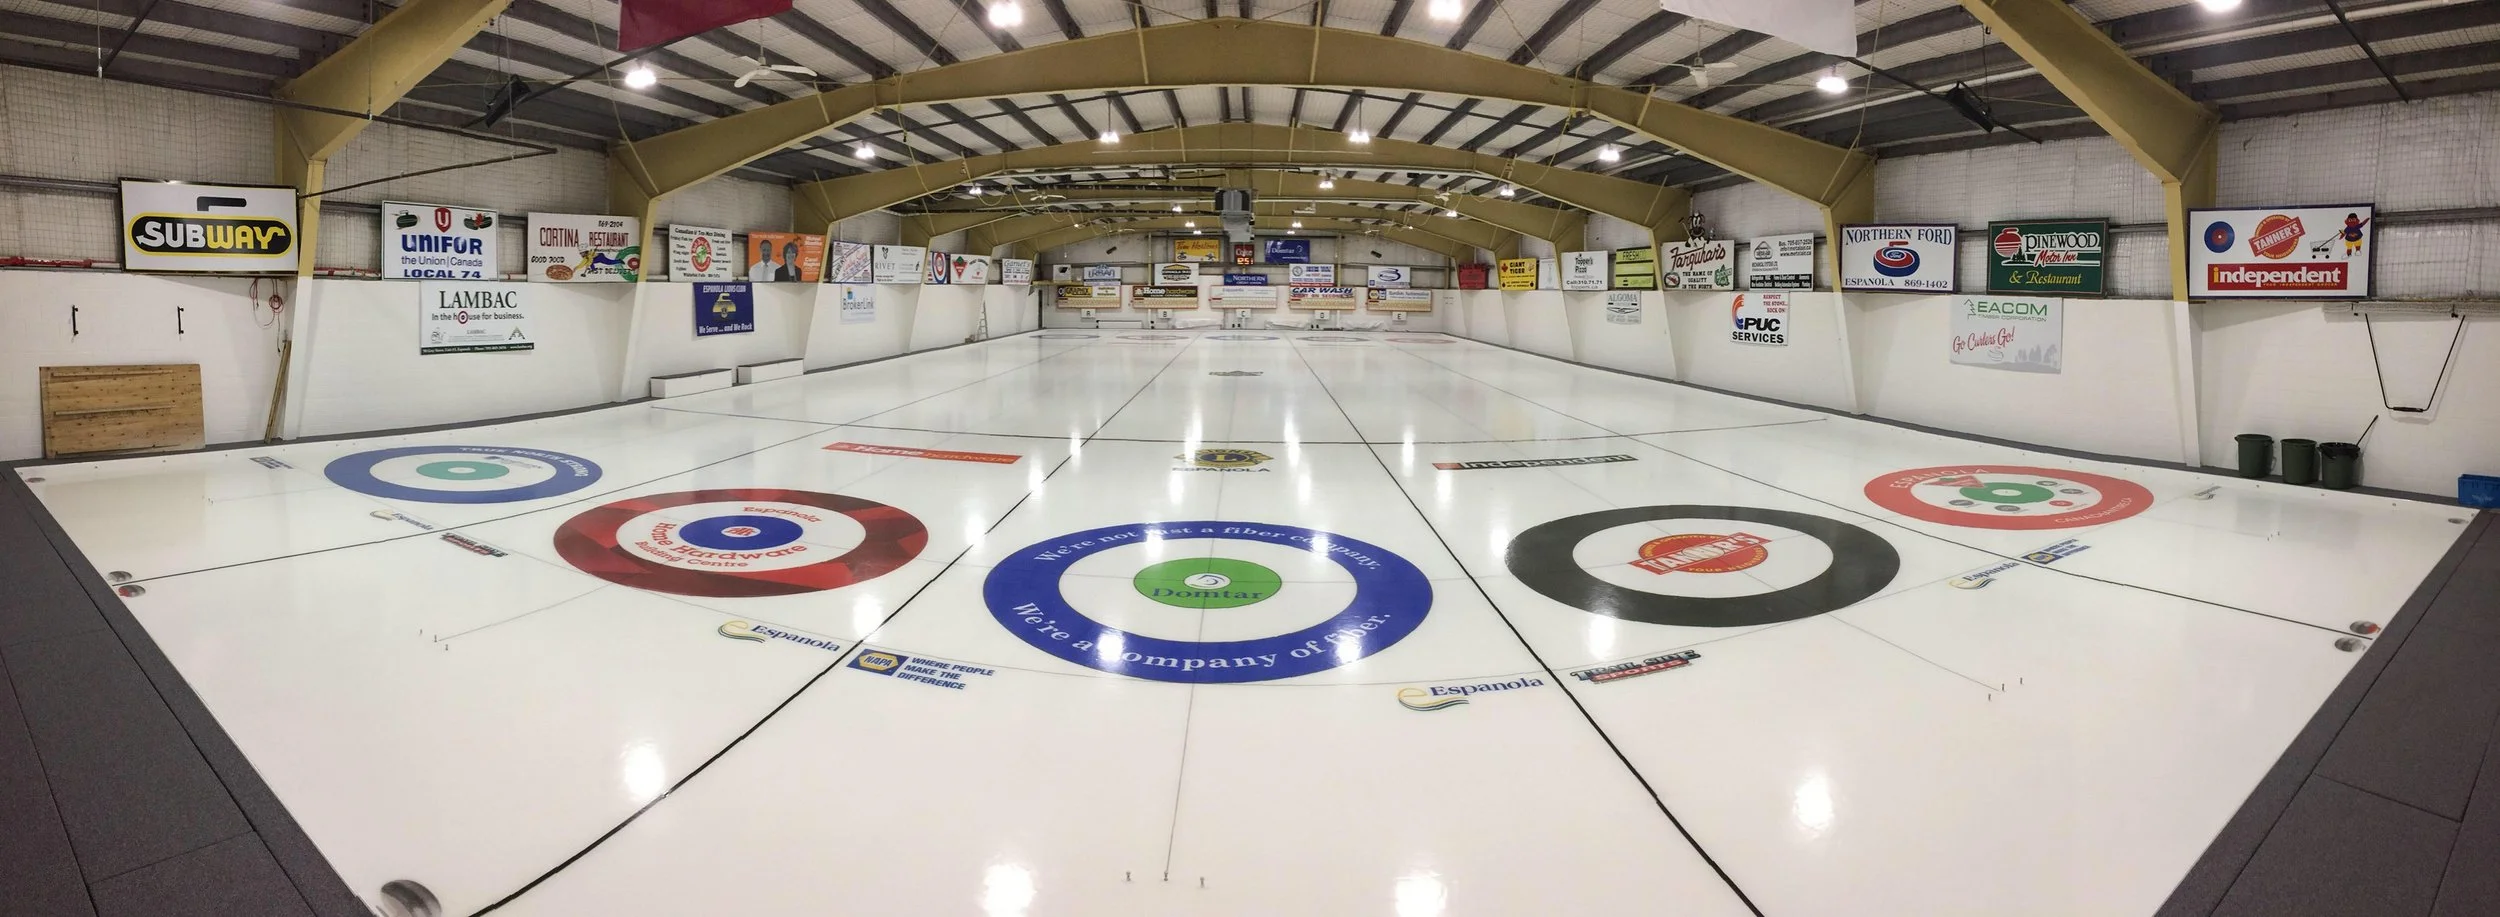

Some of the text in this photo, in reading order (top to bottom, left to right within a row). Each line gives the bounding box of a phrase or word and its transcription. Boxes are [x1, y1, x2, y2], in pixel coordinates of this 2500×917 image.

[137, 220, 285, 251] SUBWAY
[540, 227, 629, 247] CORTINA RESTAURANT
[1845, 228, 1952, 245] NORTHERN FORD
[2254, 223, 2300, 249] TANNER'S
[1177, 241, 1189, 250] Tim
[401, 256, 483, 267] the Union Canada
[1670, 243, 1726, 270] Farquhar's
[2035, 250, 2076, 266] Motor Inn
[404, 269, 481, 279] LOCAL 74
[875, 262, 896, 270] RIVET
[1845, 278, 1948, 289] ESPANOLA 869-1402
[2009, 270, 2082, 285] & Restaurant
[2213, 266, 2341, 287] independent
[702, 284, 724, 293] ESPANOLA
[1143, 287, 1166, 295] Home
[439, 290, 518, 309] LAMBAC
[842, 298, 874, 311] BrokerLink
[1608, 293, 1638, 302] ALGOMA
[494, 312, 525, 320] business.
[1977, 301, 2048, 316] EACOM
[699, 322, 753, 334] We Serve and We Rock
[1744, 317, 1781, 332] PUC
[1732, 331, 1785, 343] SERVICES
[1953, 325, 2016, 354] Go Curlers Go!
[1889, 468, 1989, 489] ESPANOLA
[742, 506, 823, 523] Espanola
[652, 522, 808, 560] Home Hardware
[1034, 539, 1096, 561] We're
[1098, 531, 1139, 543] not
[1223, 526, 1285, 538] fiber
[635, 540, 749, 567] Building Centre
[1151, 587, 1263, 600] Domtar
[751, 624, 841, 652] Espanola
[1012, 602, 1070, 641] We're
[1072, 640, 1093, 651] a
[1103, 651, 1278, 672] ompany
[1290, 640, 1327, 659] of
[863, 655, 893, 668] NAPA
[912, 657, 995, 677] WHERE PEOPLE
[903, 665, 962, 681] MAKE THE
[897, 672, 967, 691] DIFFERENCE
[1429, 676, 1545, 698] Espanola
